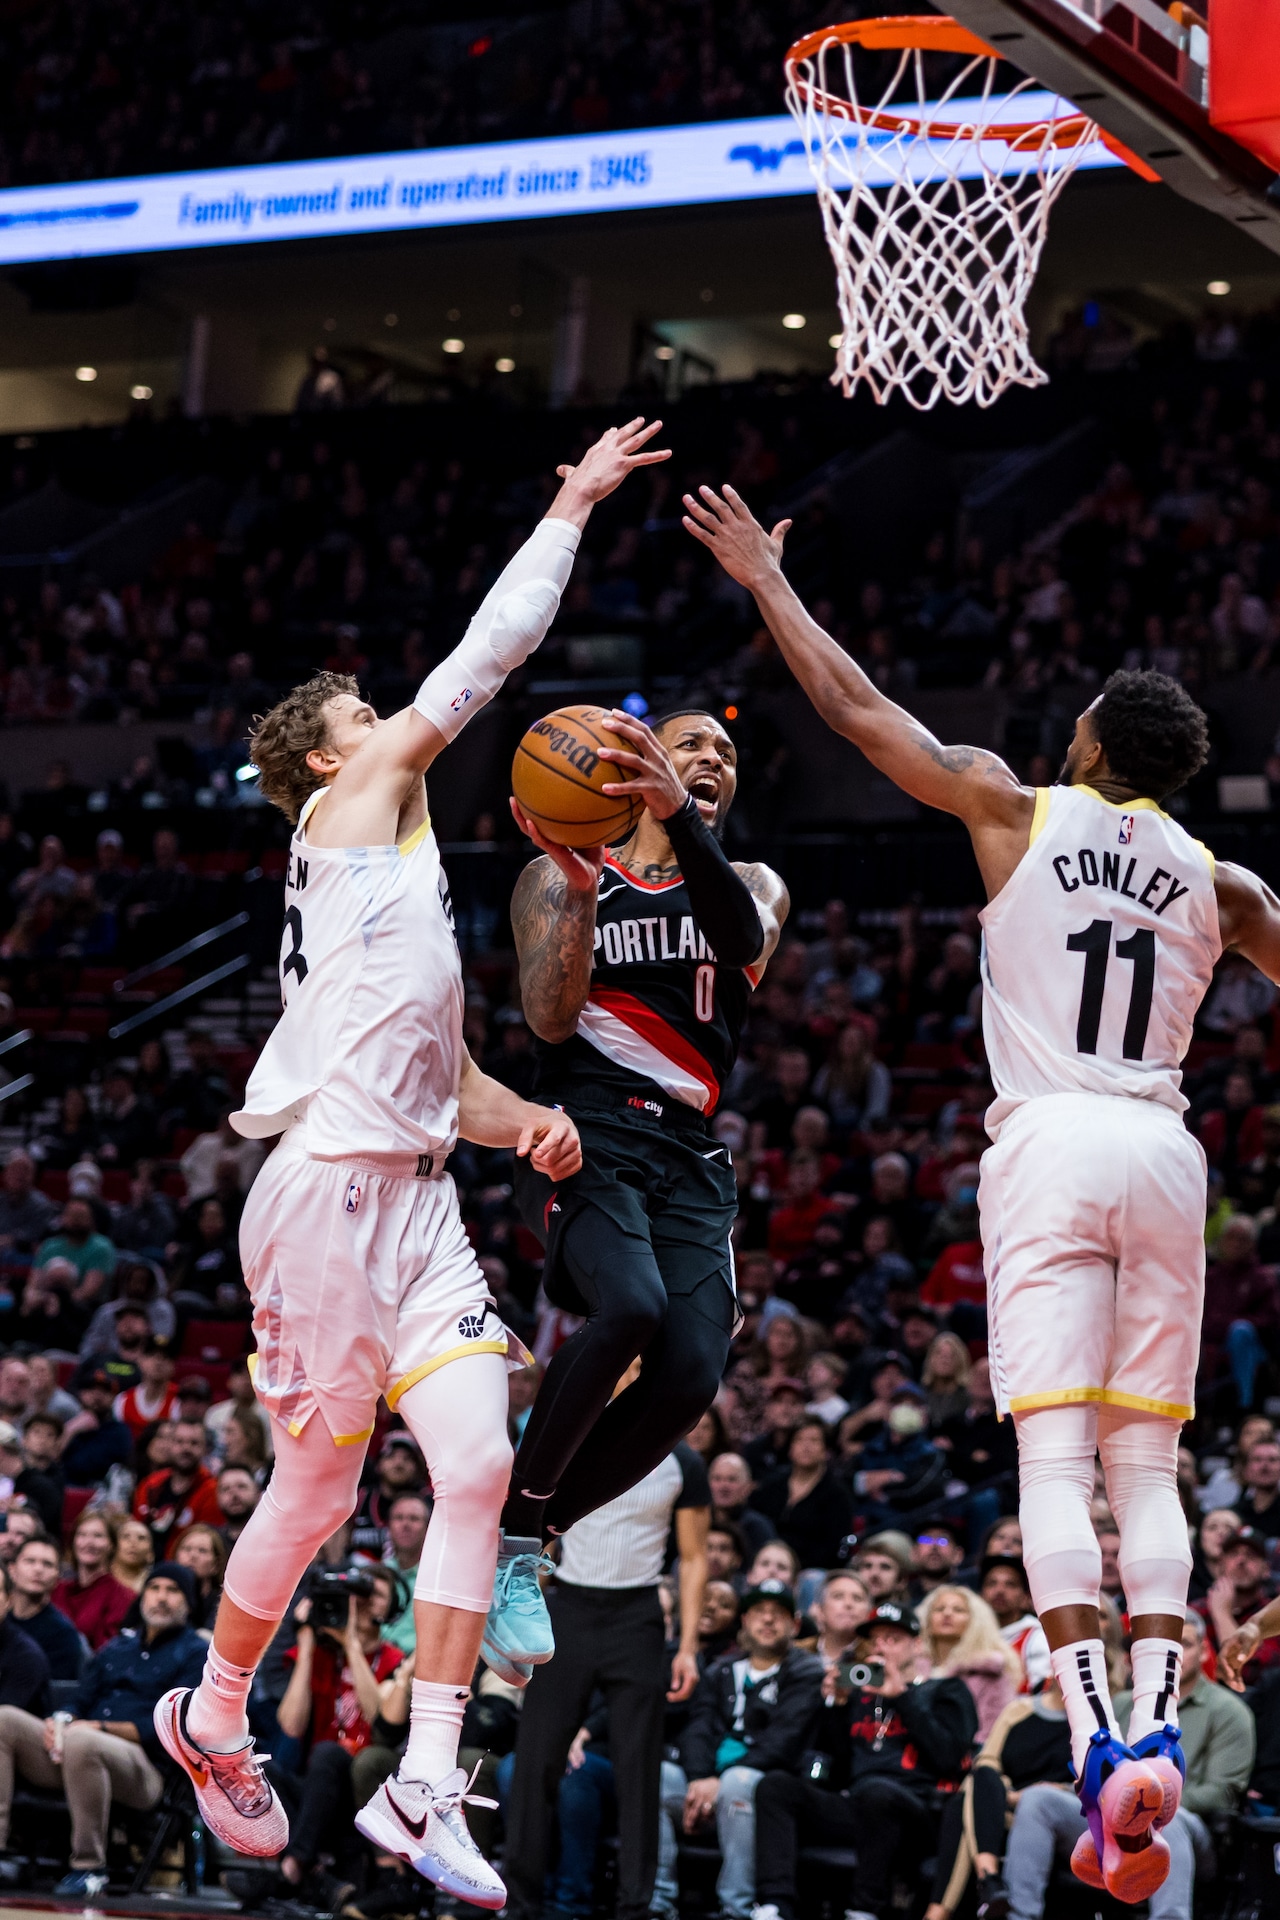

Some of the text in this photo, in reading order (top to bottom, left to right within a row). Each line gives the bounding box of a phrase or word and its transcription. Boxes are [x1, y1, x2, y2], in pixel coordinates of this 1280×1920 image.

[348, 175, 394, 212] and
[398, 166, 510, 213] operated
[515, 161, 583, 198] since
[530, 720, 600, 779] Wilson
[1052, 848, 1190, 917] CONLEY
[695, 964, 715, 1022] 0
[1066, 918, 1156, 1062] 11
